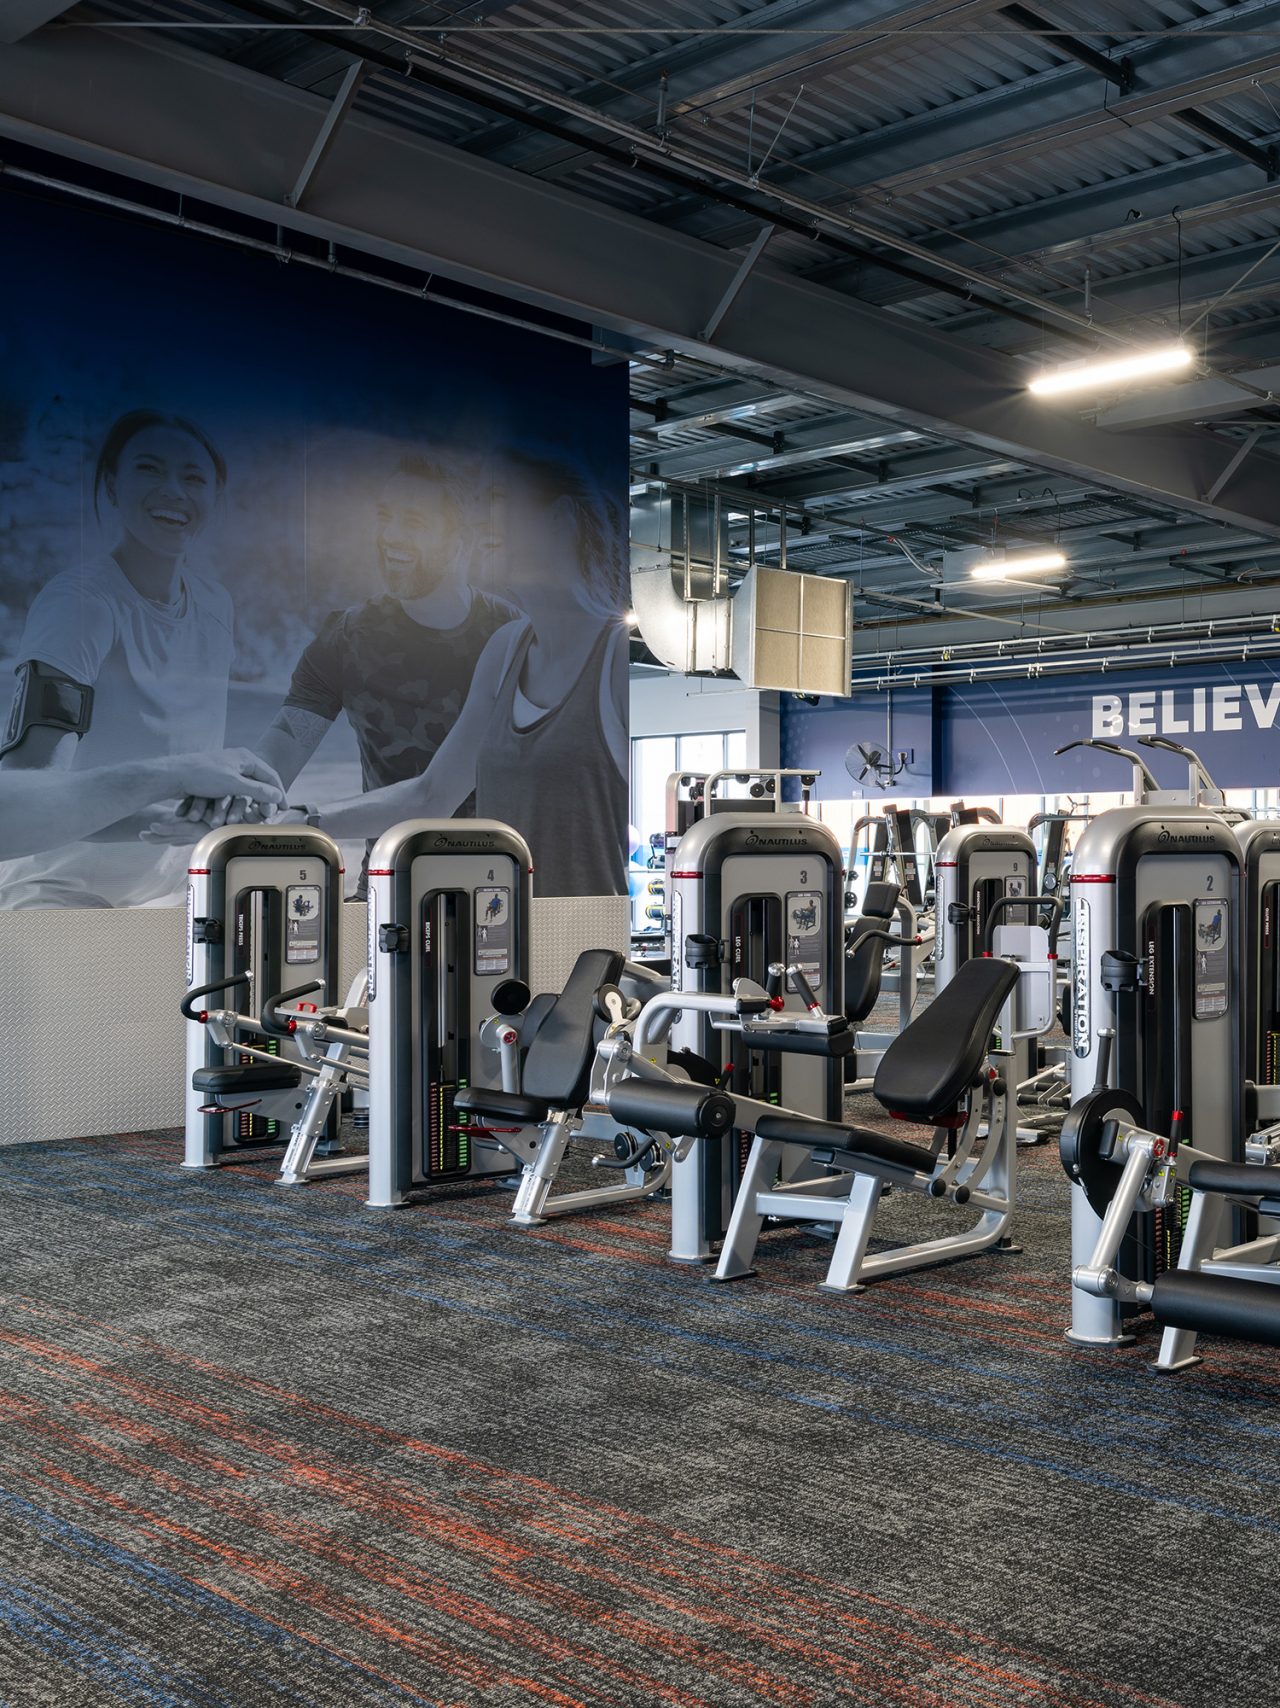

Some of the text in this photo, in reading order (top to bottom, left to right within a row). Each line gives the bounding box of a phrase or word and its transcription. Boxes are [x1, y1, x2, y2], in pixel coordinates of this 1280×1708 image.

[447, 840, 495, 848] NAUTILUS
[758, 838, 808, 846] NAUTILUS
[1169, 835, 1215, 844] NAUTILUS
[1012, 862, 1018, 872] 9
[299, 869, 307, 881] 5
[487, 869, 495, 882] 4
[800, 870, 808, 884] 3
[1206, 875, 1214, 892] 2
[1078, 909, 1090, 1047] INSPIRATION
